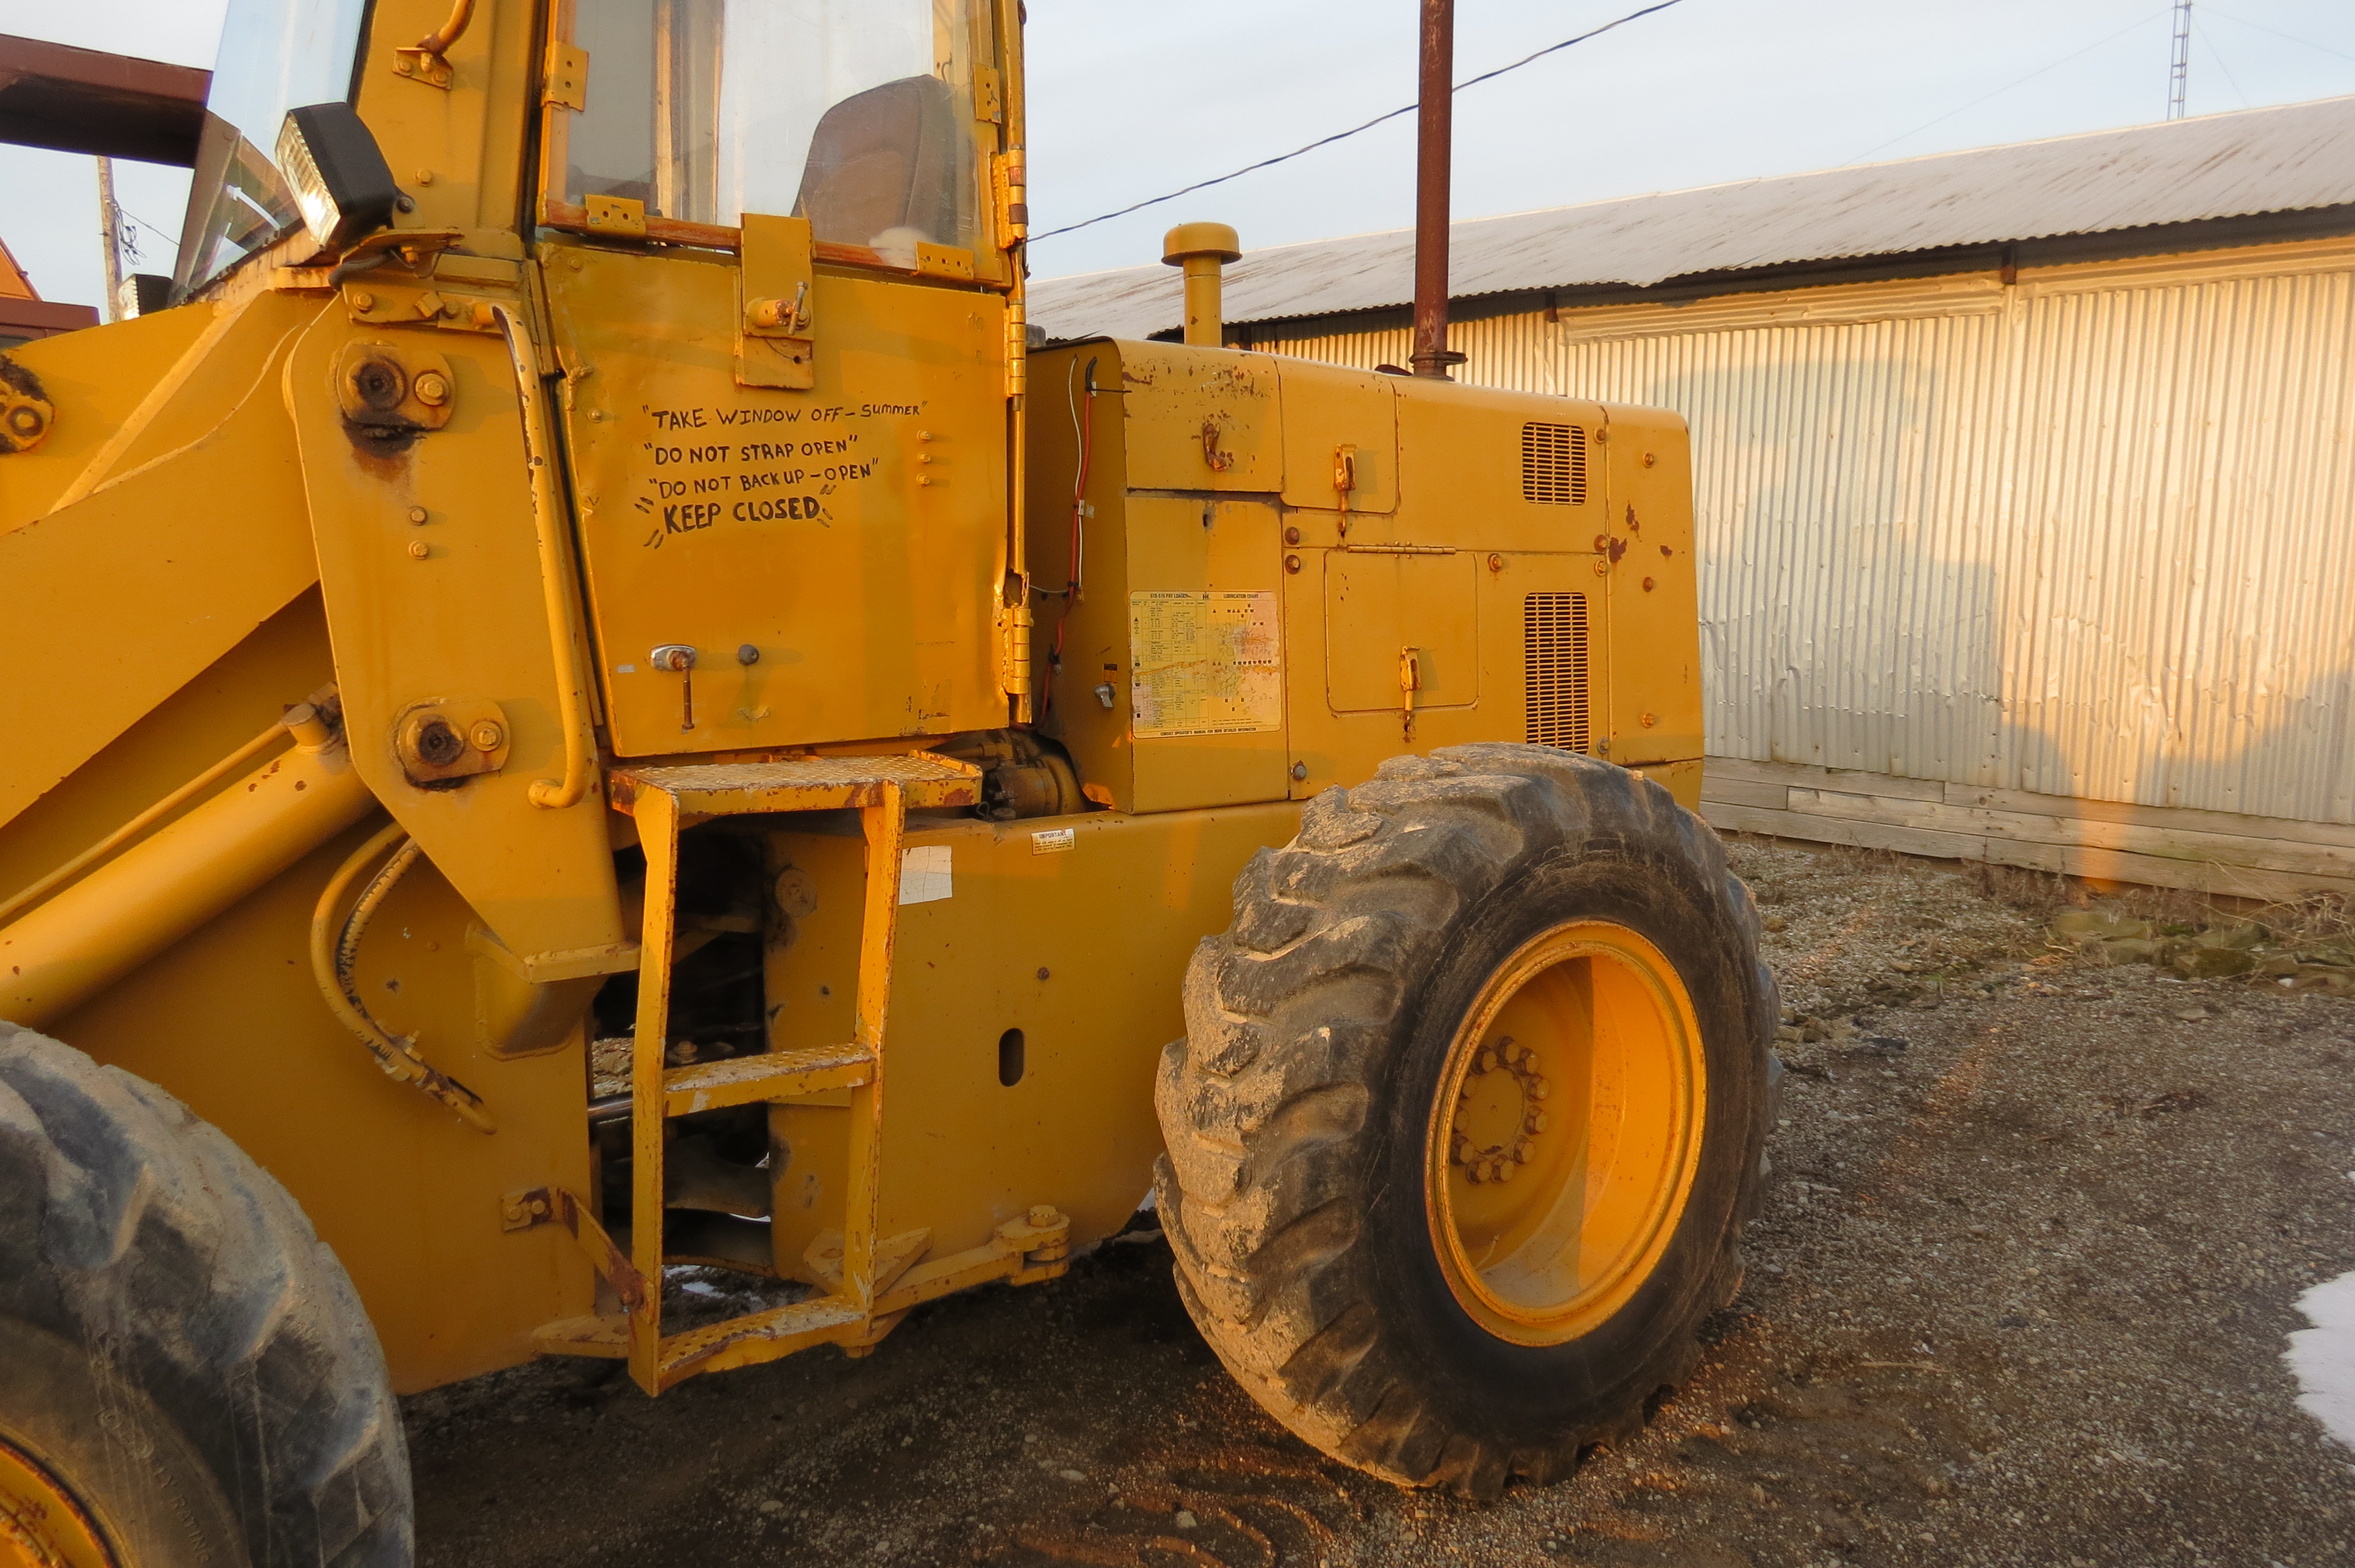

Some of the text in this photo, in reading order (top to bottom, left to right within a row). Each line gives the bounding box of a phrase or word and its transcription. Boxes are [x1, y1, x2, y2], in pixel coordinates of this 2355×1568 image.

[715, 408, 801, 426] WINDOW
[689, 445, 730, 464] NOT
[741, 443, 794, 461] STRAP
[694, 476, 731, 494] NOT
